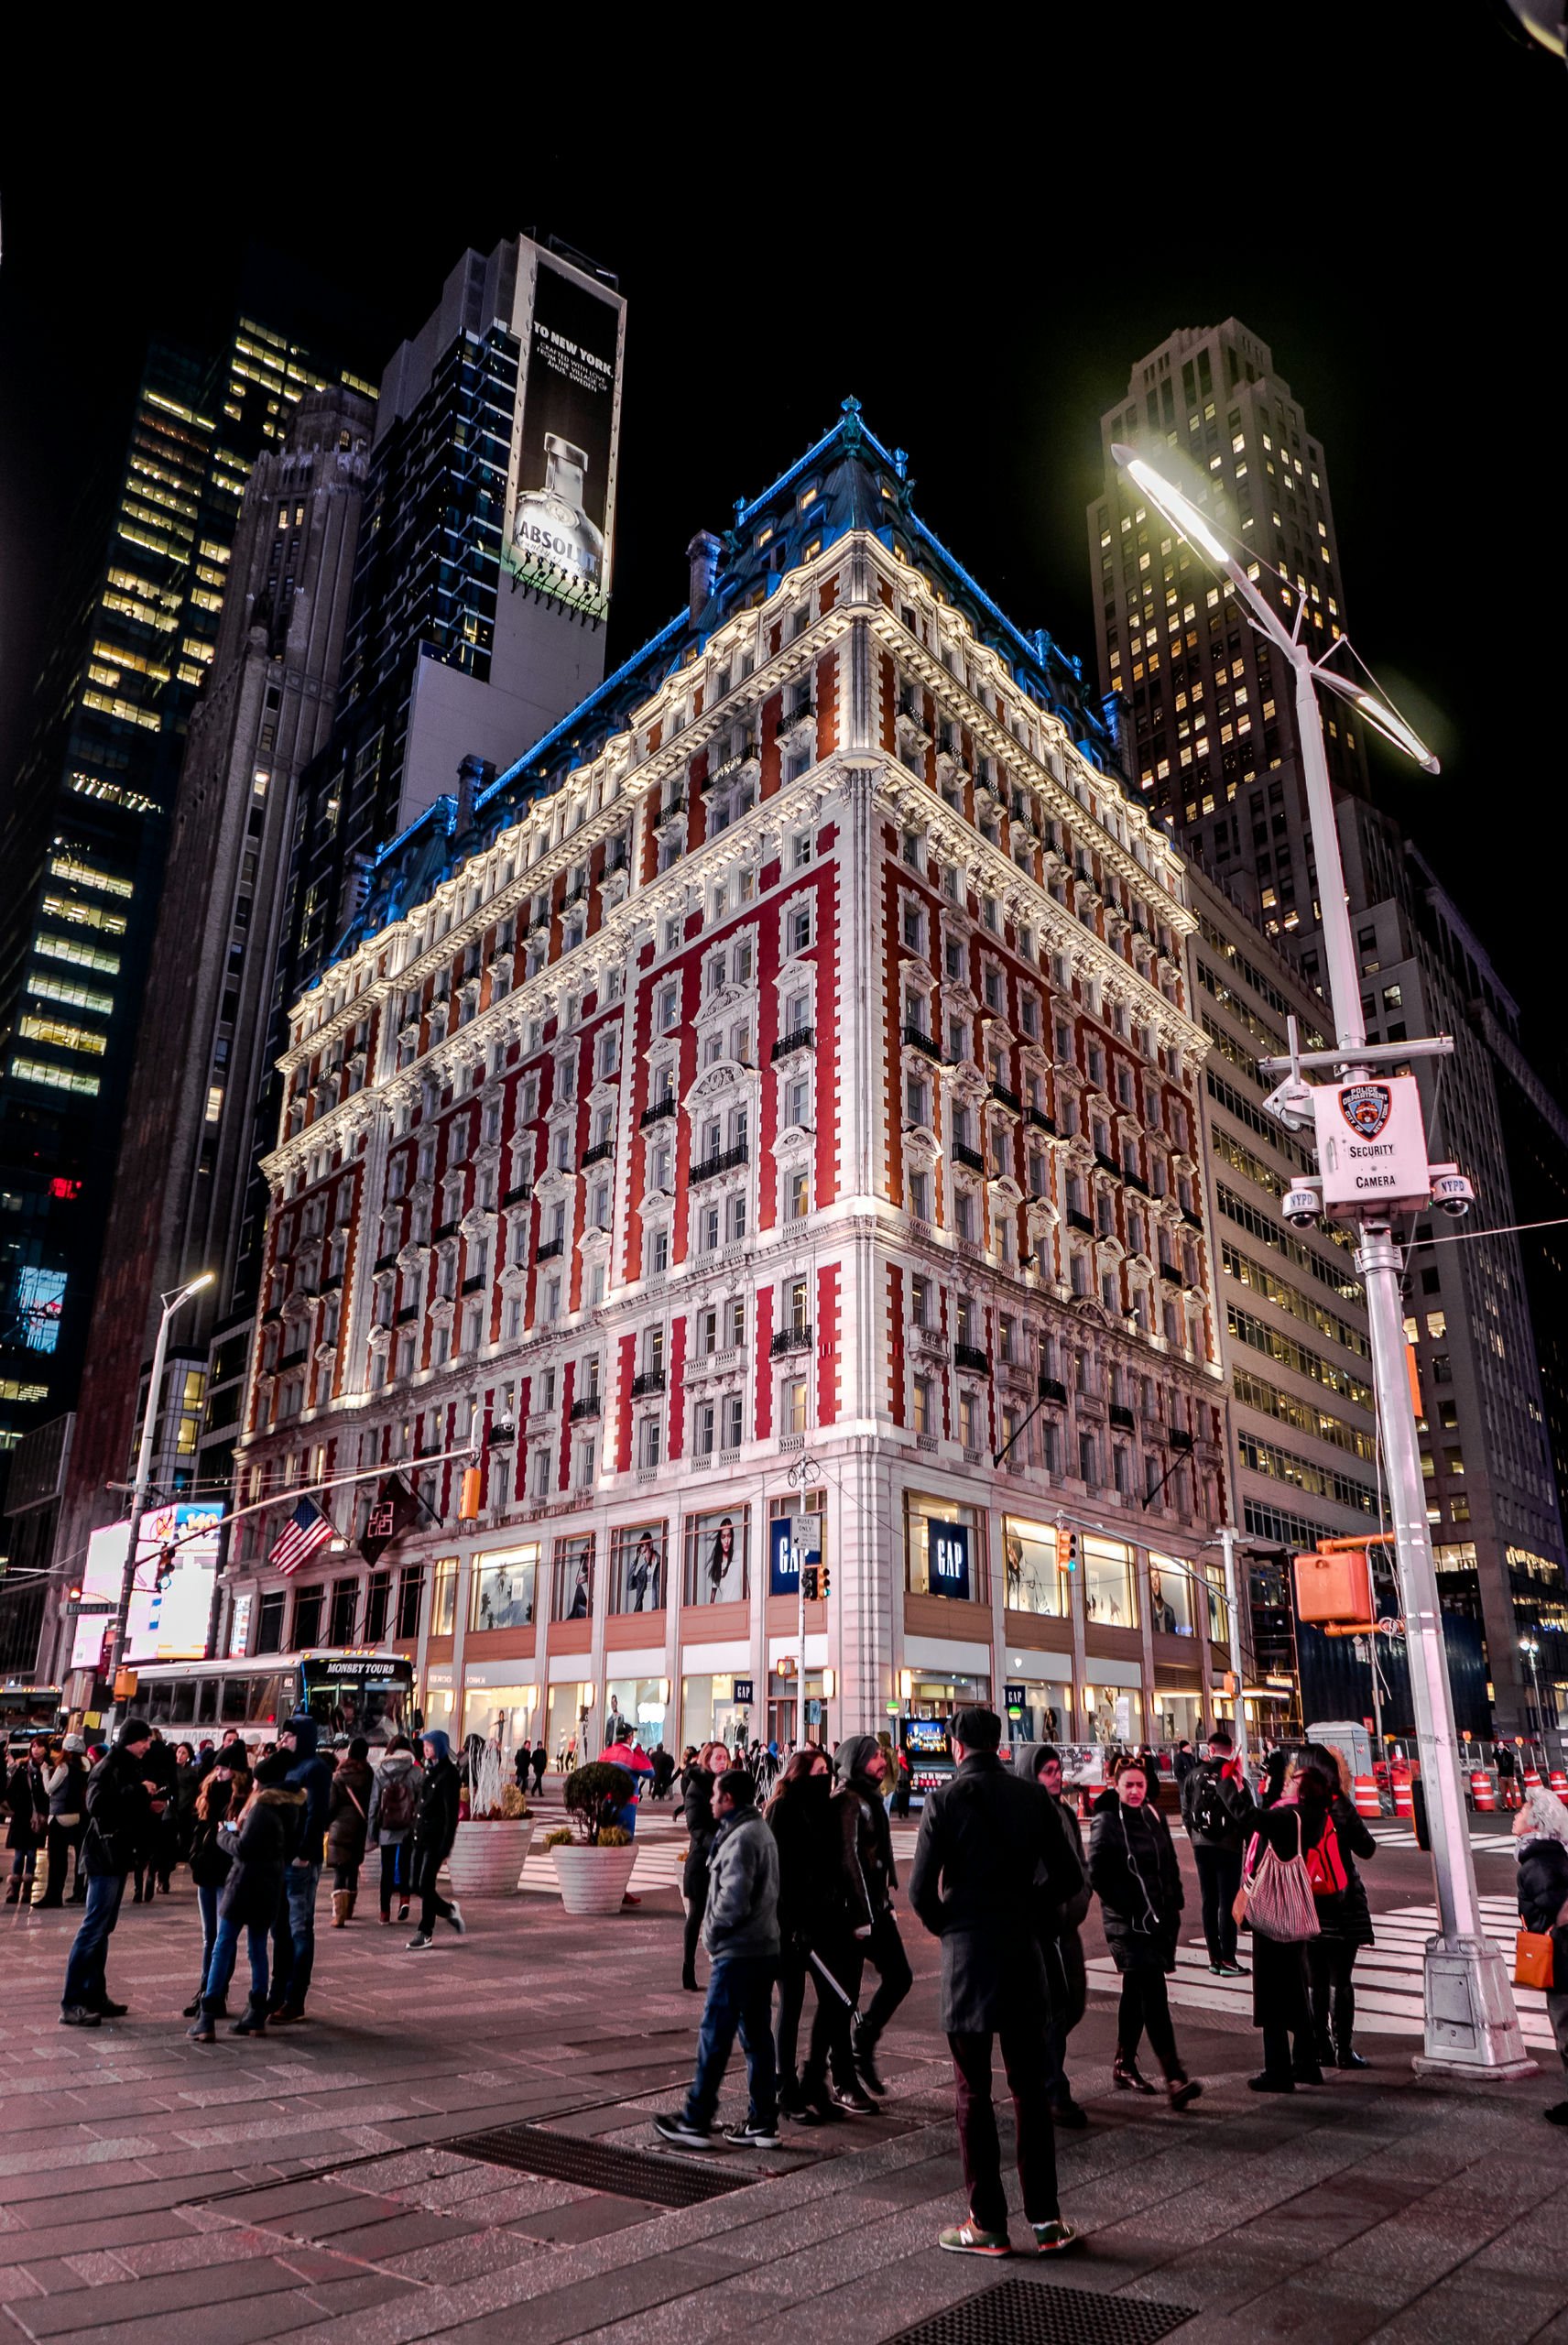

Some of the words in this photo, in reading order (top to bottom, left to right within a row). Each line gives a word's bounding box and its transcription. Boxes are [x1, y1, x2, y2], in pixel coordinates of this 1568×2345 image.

[534, 321, 550, 338] TO
[550, 331, 577, 355] NEW
[580, 348, 614, 378] YORK.
[537, 346, 556, 362] FROM
[540, 342, 569, 363] CRAFTED
[571, 358, 588, 374] WITH
[589, 369, 605, 384] LOVE
[570, 372, 597, 393] SWEDEN
[519, 520, 594, 573] ABSOLUT
[1351, 1086, 1377, 1095] POLICE
[1343, 1093, 1388, 1106] DEPARTMENT
[1349, 1144, 1394, 1158] SECURITY
[1356, 1175, 1396, 1189] CAMERA
[1442, 1179, 1465, 1193] NYPD
[1290, 1193, 1313, 1206] NYPD
[937, 1539, 963, 1578] GAP
[69, 1604, 105, 1614] Broadway
[326, 1663, 365, 1674] MONSEY
[365, 1663, 395, 1674] TOURS
[737, 1685, 750, 1699] GAP
[1008, 1691, 1021, 1703] GAP
[960, 2228, 973, 2244] N
